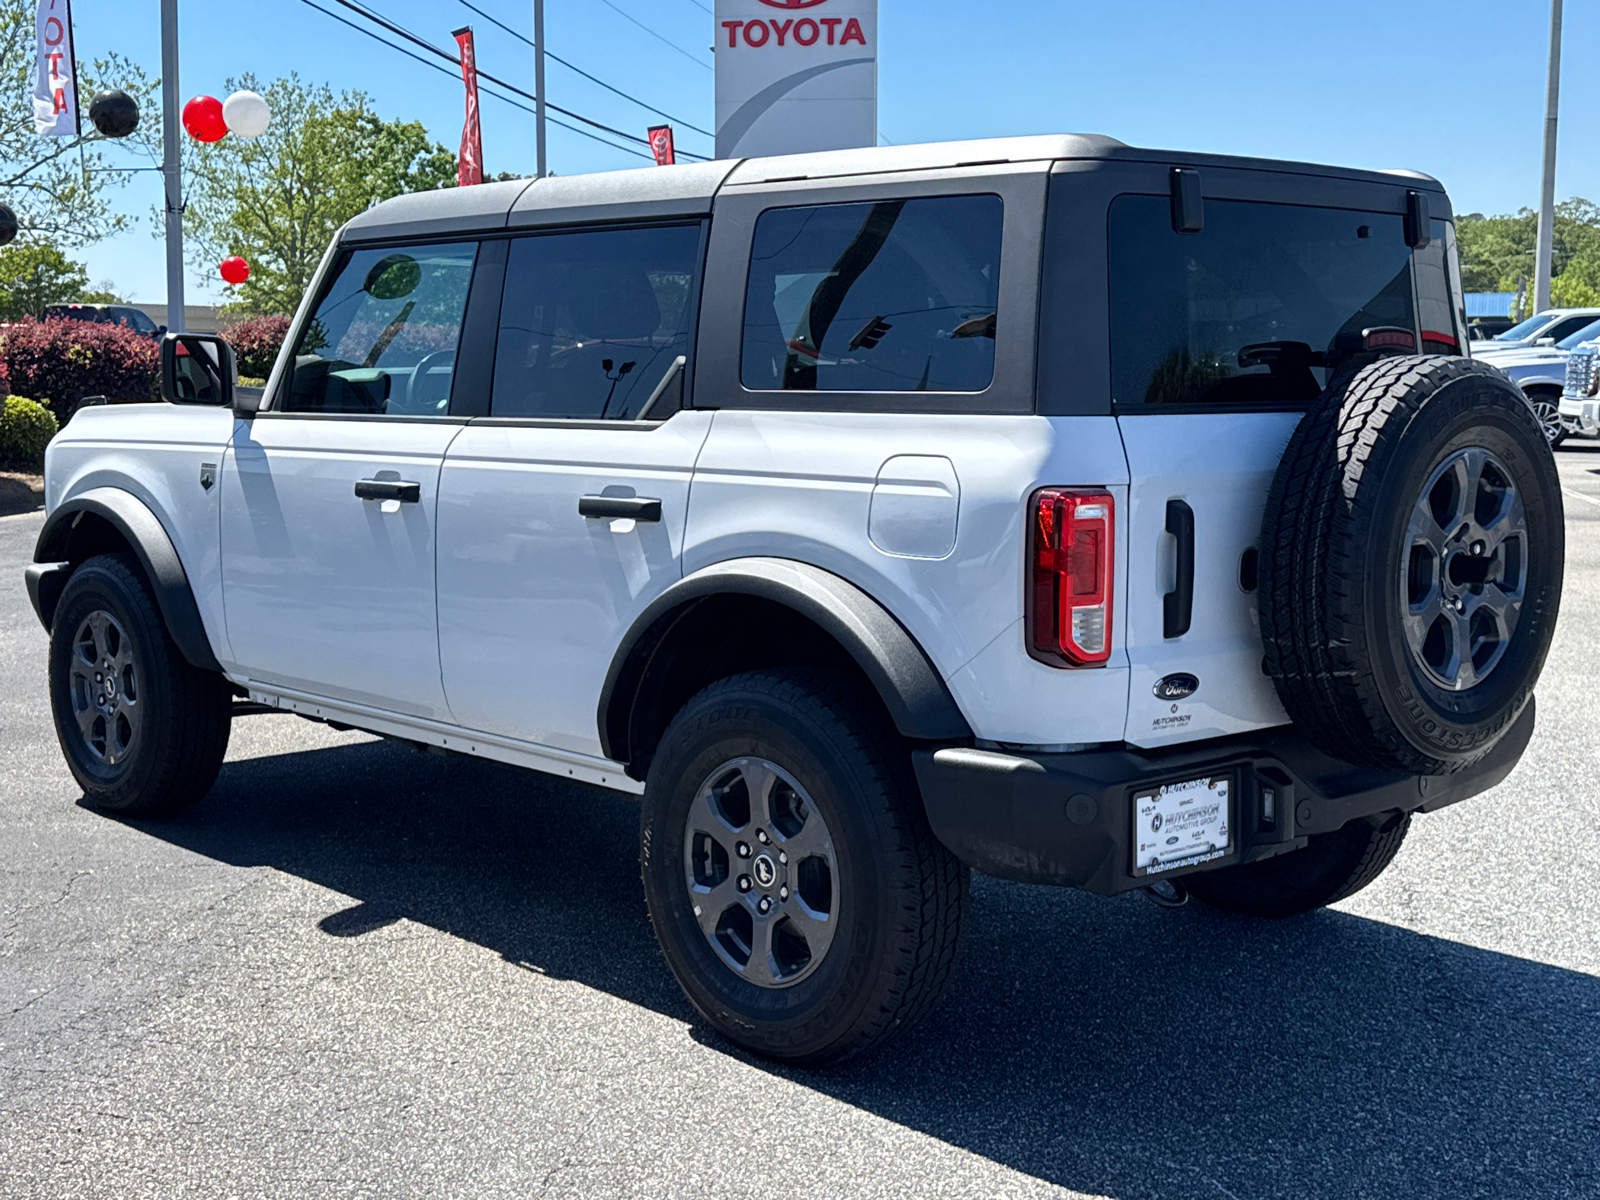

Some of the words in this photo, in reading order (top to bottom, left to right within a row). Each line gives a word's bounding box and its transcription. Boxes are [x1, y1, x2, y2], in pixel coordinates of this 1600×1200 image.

[721, 17, 866, 48] TOYOTA
[1168, 777, 1211, 795] HUTCHINSON
[1165, 804, 1220, 827] HUTCHINSON
[1165, 820, 1200, 834] AUTOMOTIVE
[1200, 815, 1218, 826] GROUP
[1146, 850, 1225, 875] Hutchinsonautogroup.com
